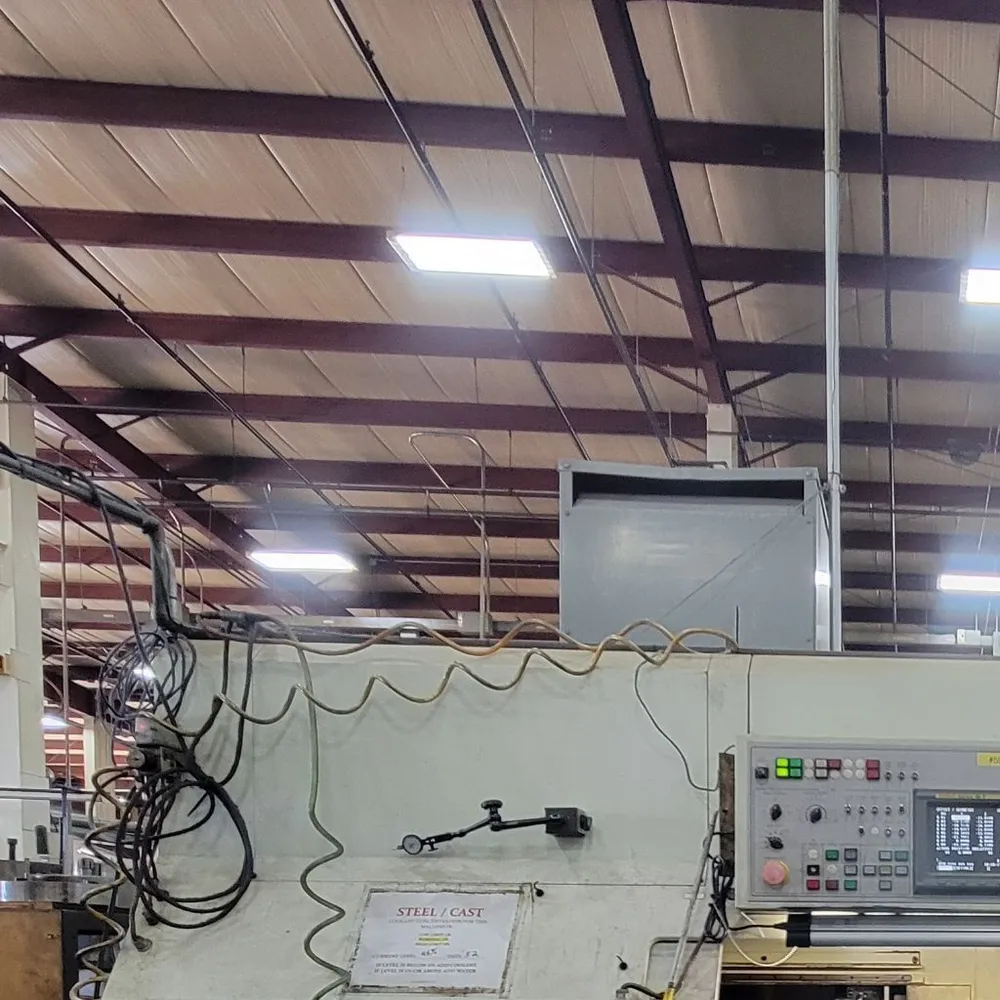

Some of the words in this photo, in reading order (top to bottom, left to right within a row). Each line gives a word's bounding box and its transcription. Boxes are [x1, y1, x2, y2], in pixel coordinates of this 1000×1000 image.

[397, 907, 437, 917] STEEL
[441, 907, 447, 917] /
[449, 907, 484, 917] CAST
